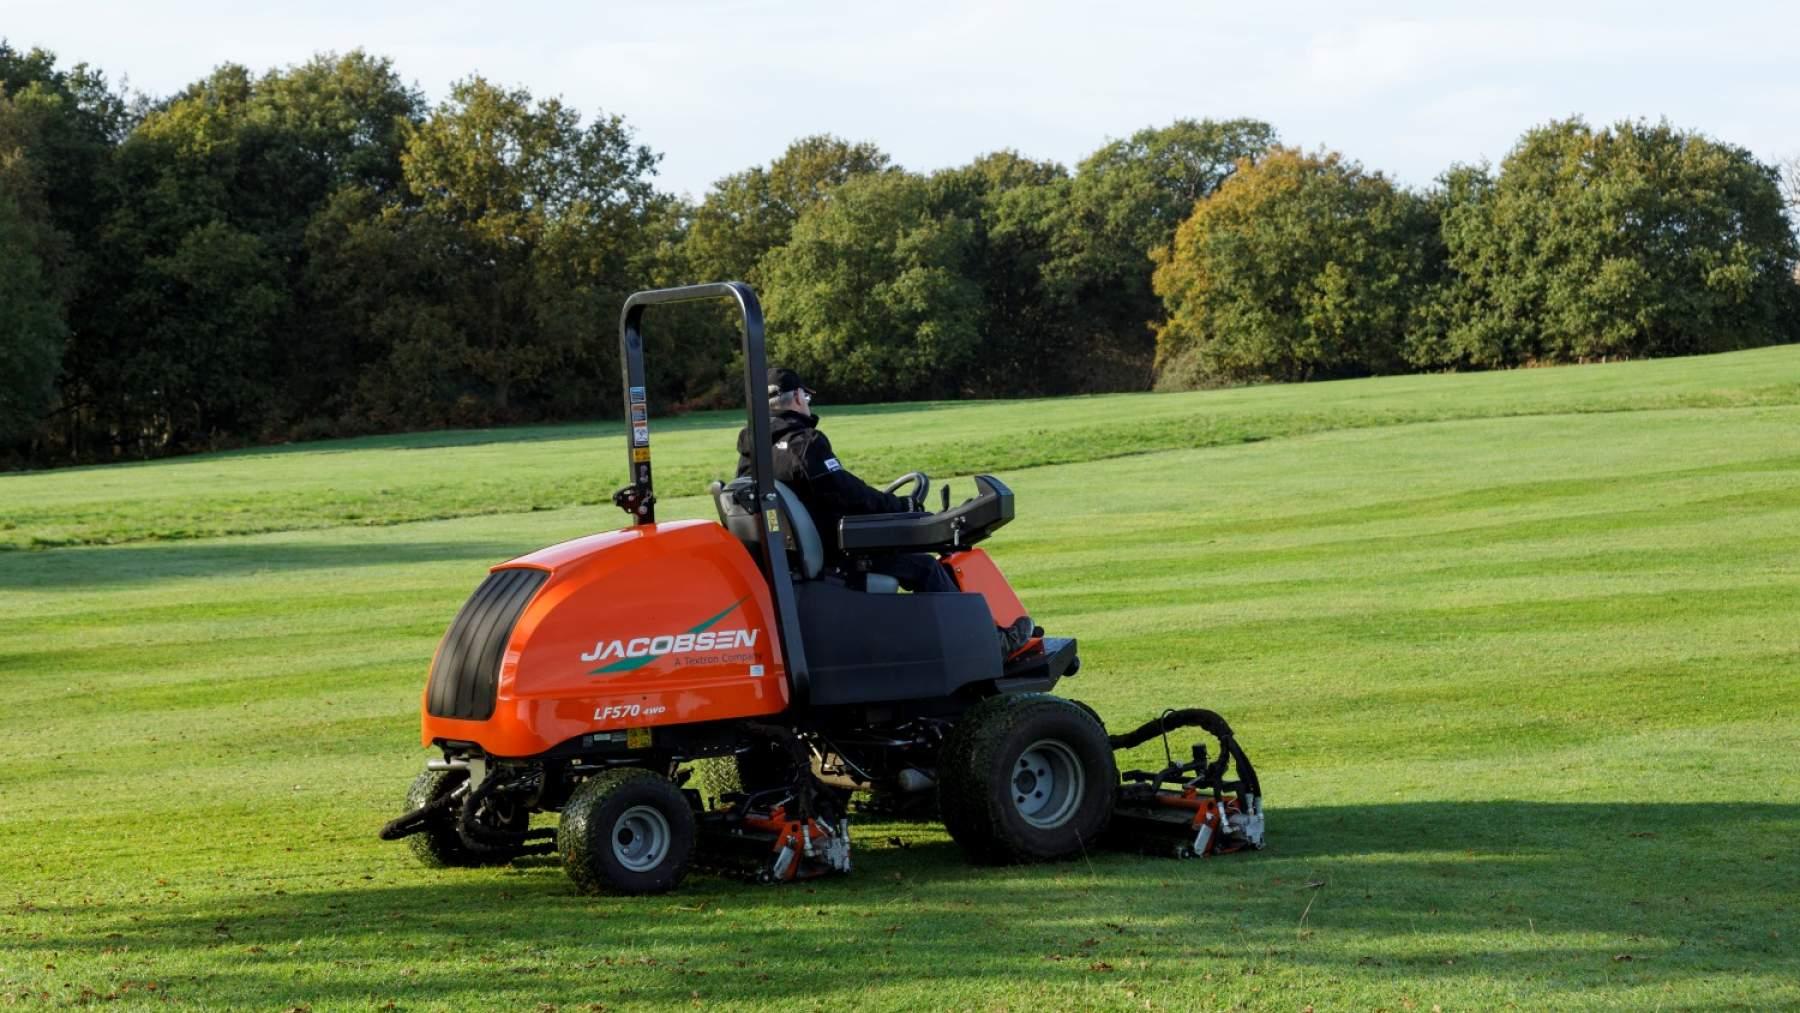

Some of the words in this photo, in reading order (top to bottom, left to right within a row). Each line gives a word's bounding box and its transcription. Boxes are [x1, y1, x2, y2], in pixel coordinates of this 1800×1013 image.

[581, 629, 758, 662] JACOBSEN
[674, 657, 681, 666] A
[684, 654, 719, 665] Textron
[593, 704, 640, 720] LF570
[642, 706, 666, 715] 4WD
